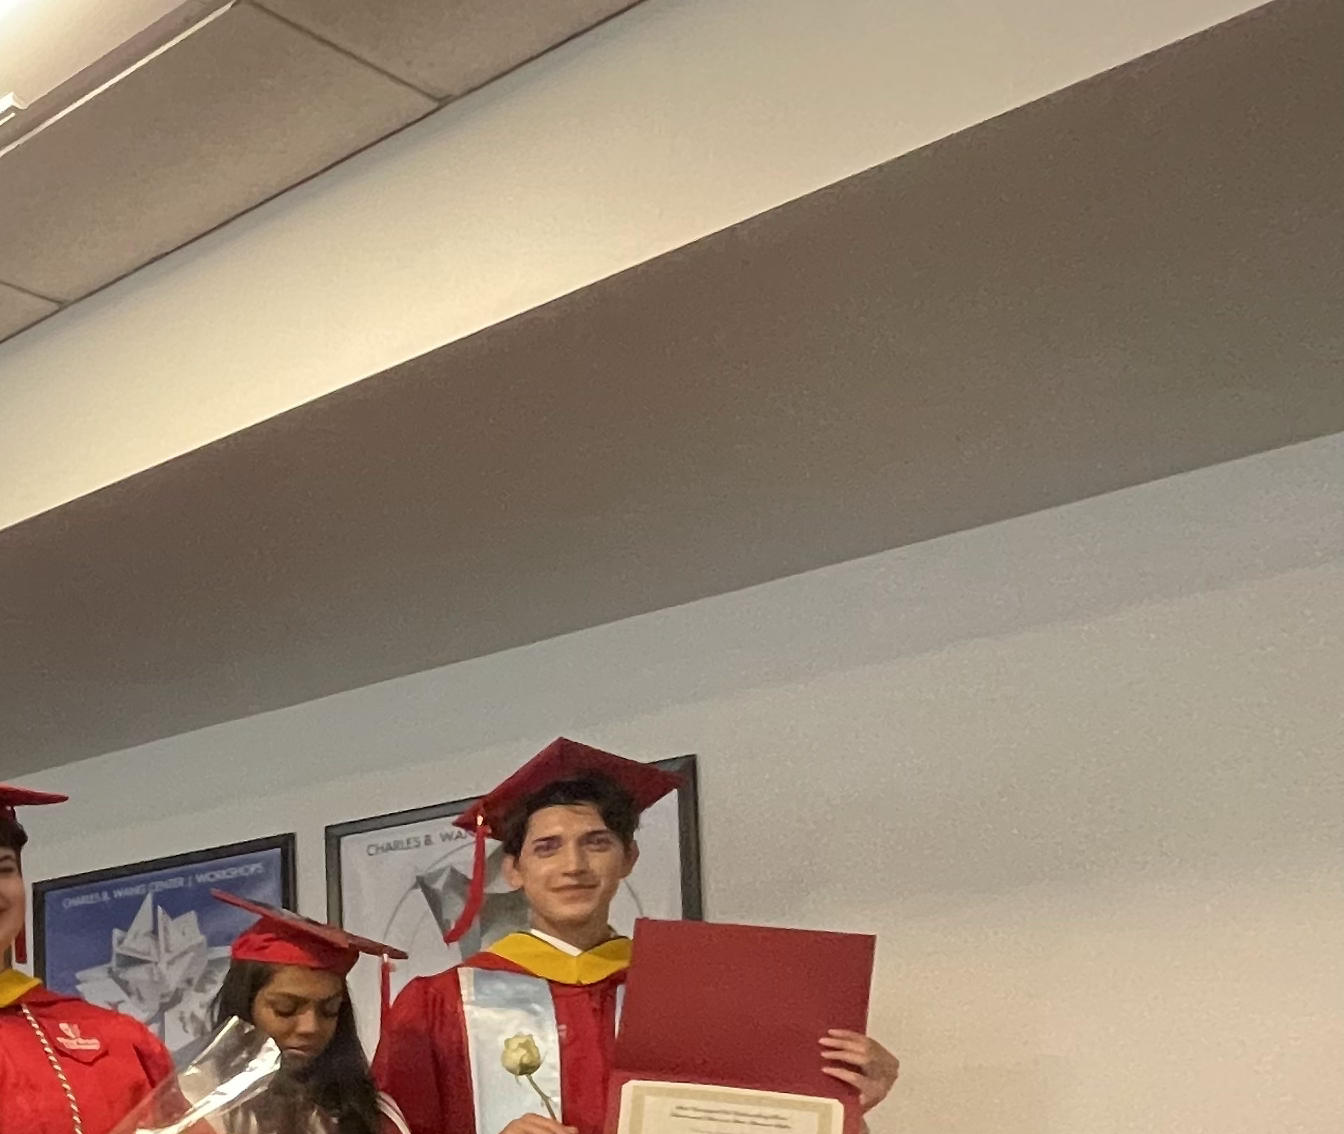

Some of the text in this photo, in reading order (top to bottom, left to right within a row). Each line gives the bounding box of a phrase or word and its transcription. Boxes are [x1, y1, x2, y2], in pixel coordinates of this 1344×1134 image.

[367, 837, 421, 856] CHARLES
[439, 830, 467, 842] WA
[148, 876, 184, 892] CENTER
[195, 863, 263, 883] WORKSHOPS
